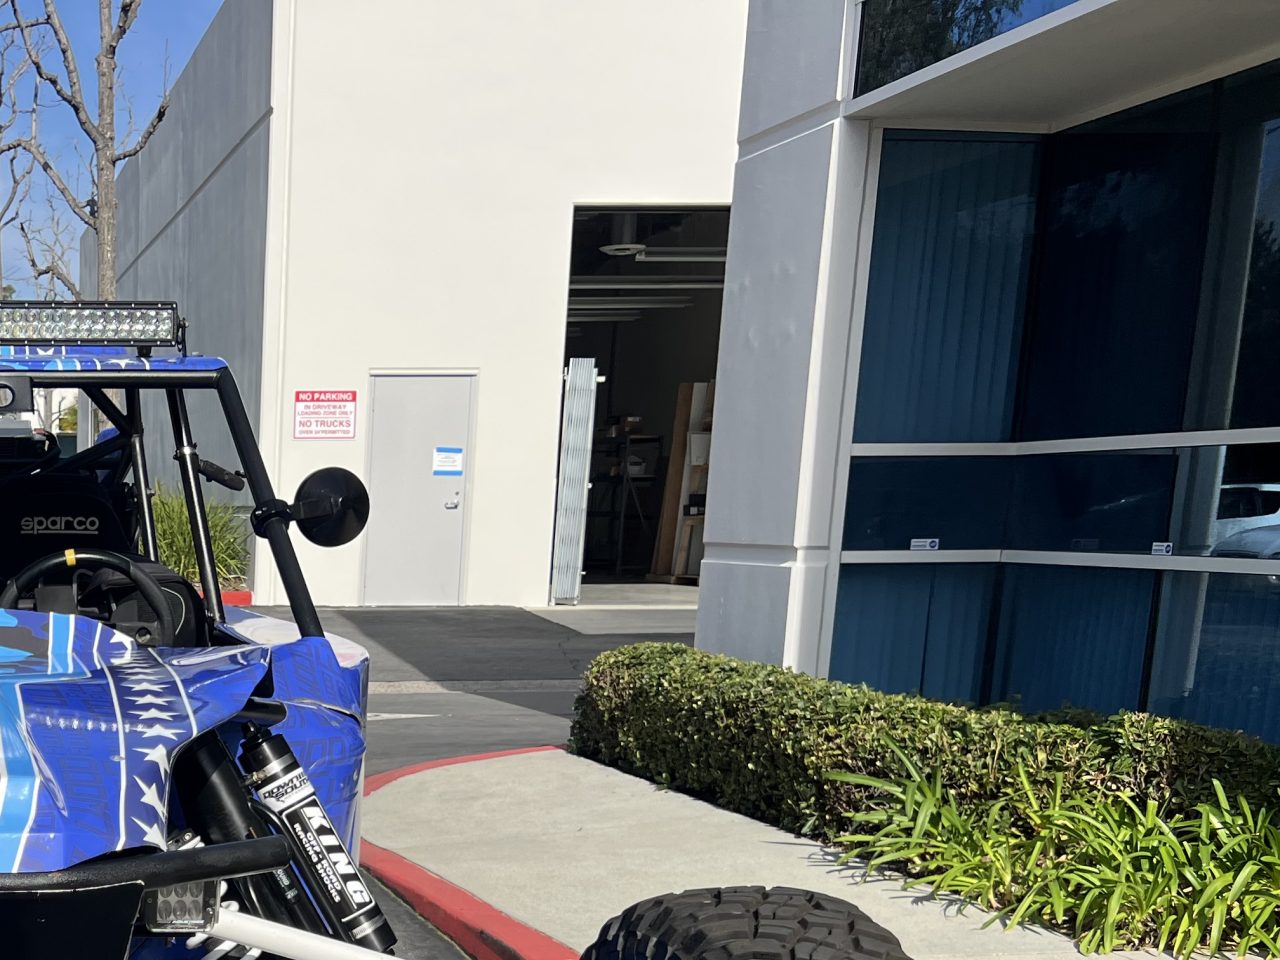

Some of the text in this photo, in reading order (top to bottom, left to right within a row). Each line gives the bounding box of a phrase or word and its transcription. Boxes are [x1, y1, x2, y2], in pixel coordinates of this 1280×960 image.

[298, 392, 353, 401] NO PARKING
[298, 419, 352, 428] NO TRUCKS
[20, 516, 99, 535] sparco
[293, 823, 318, 863] RACING
[316, 862, 341, 903] SHOCKS
[303, 806, 371, 904] KING
